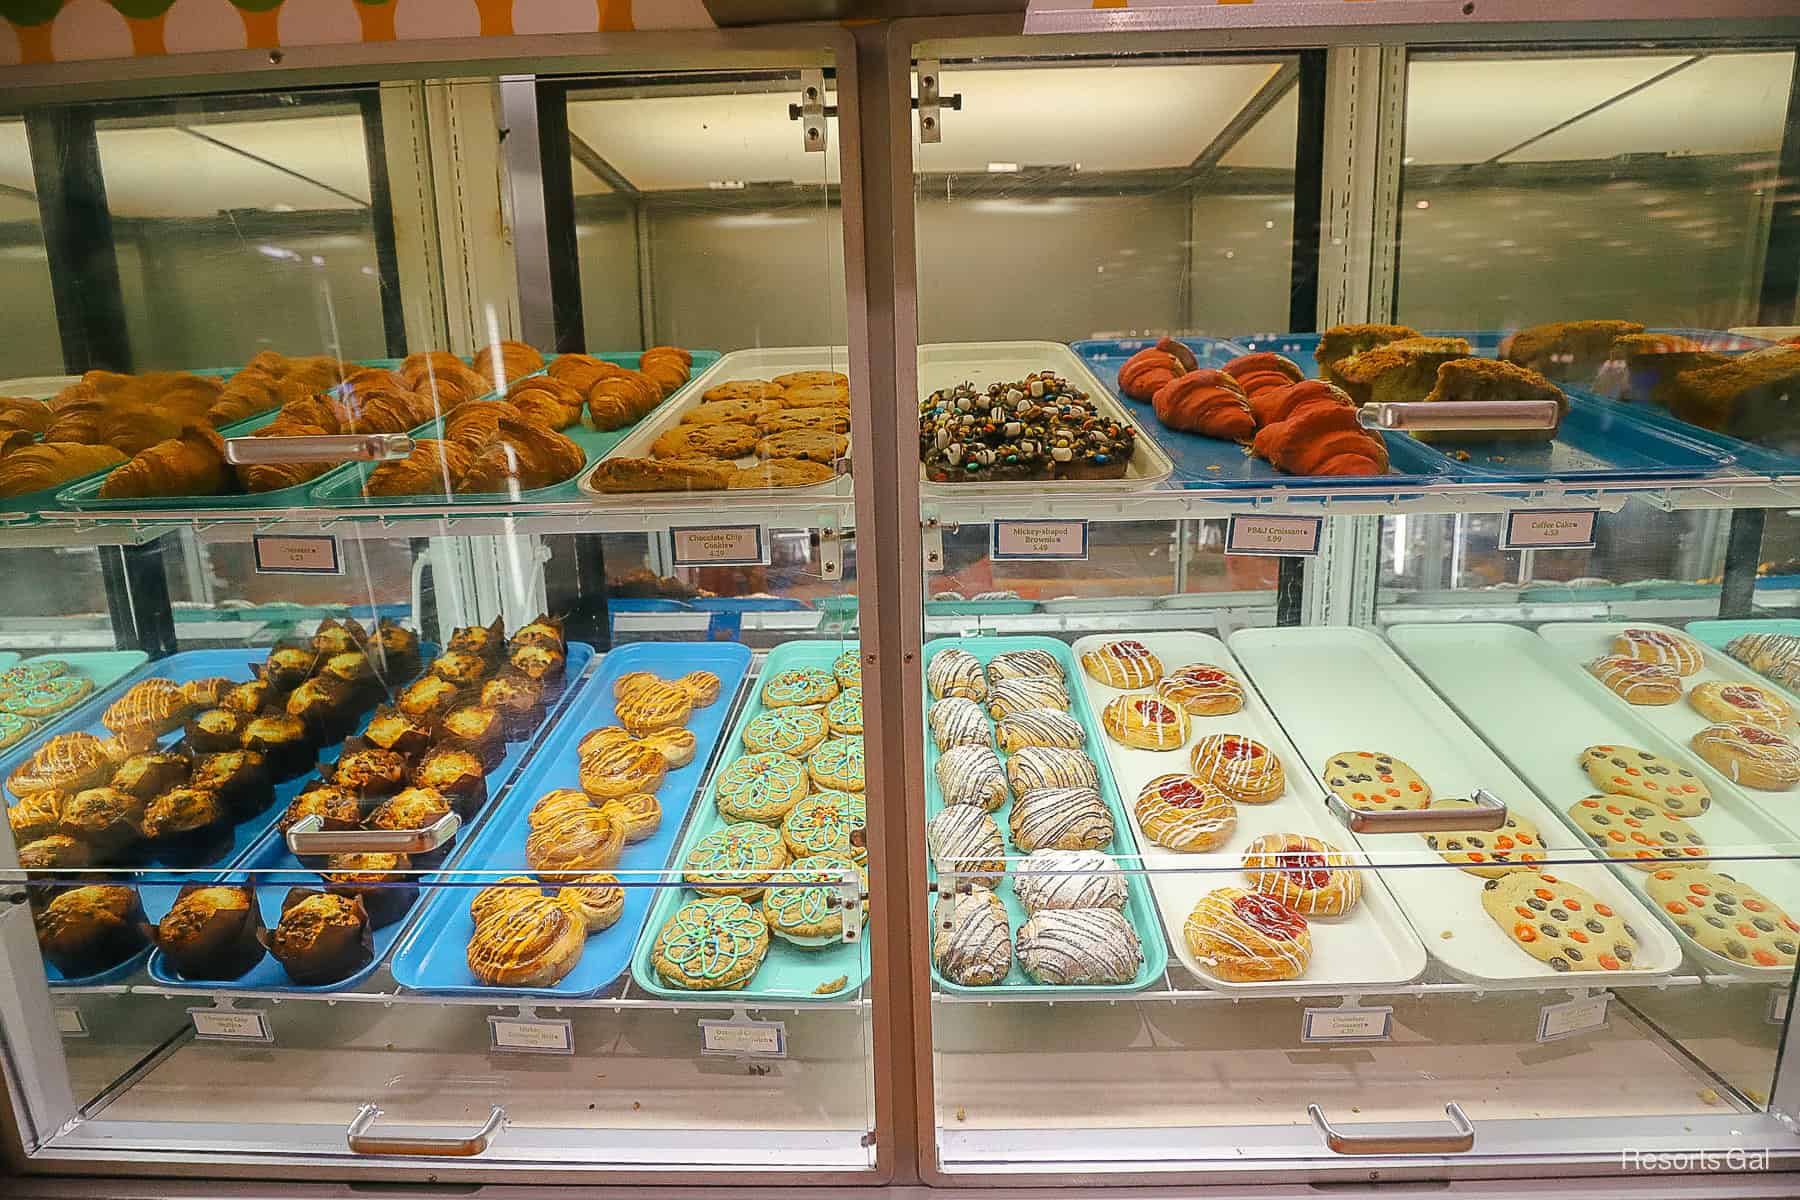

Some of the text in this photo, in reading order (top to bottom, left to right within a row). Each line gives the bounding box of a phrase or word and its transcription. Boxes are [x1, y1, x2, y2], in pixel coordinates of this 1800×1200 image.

[1531, 521, 1555, 529] Coffee
[688, 533, 743, 543] Chocolate Chip
